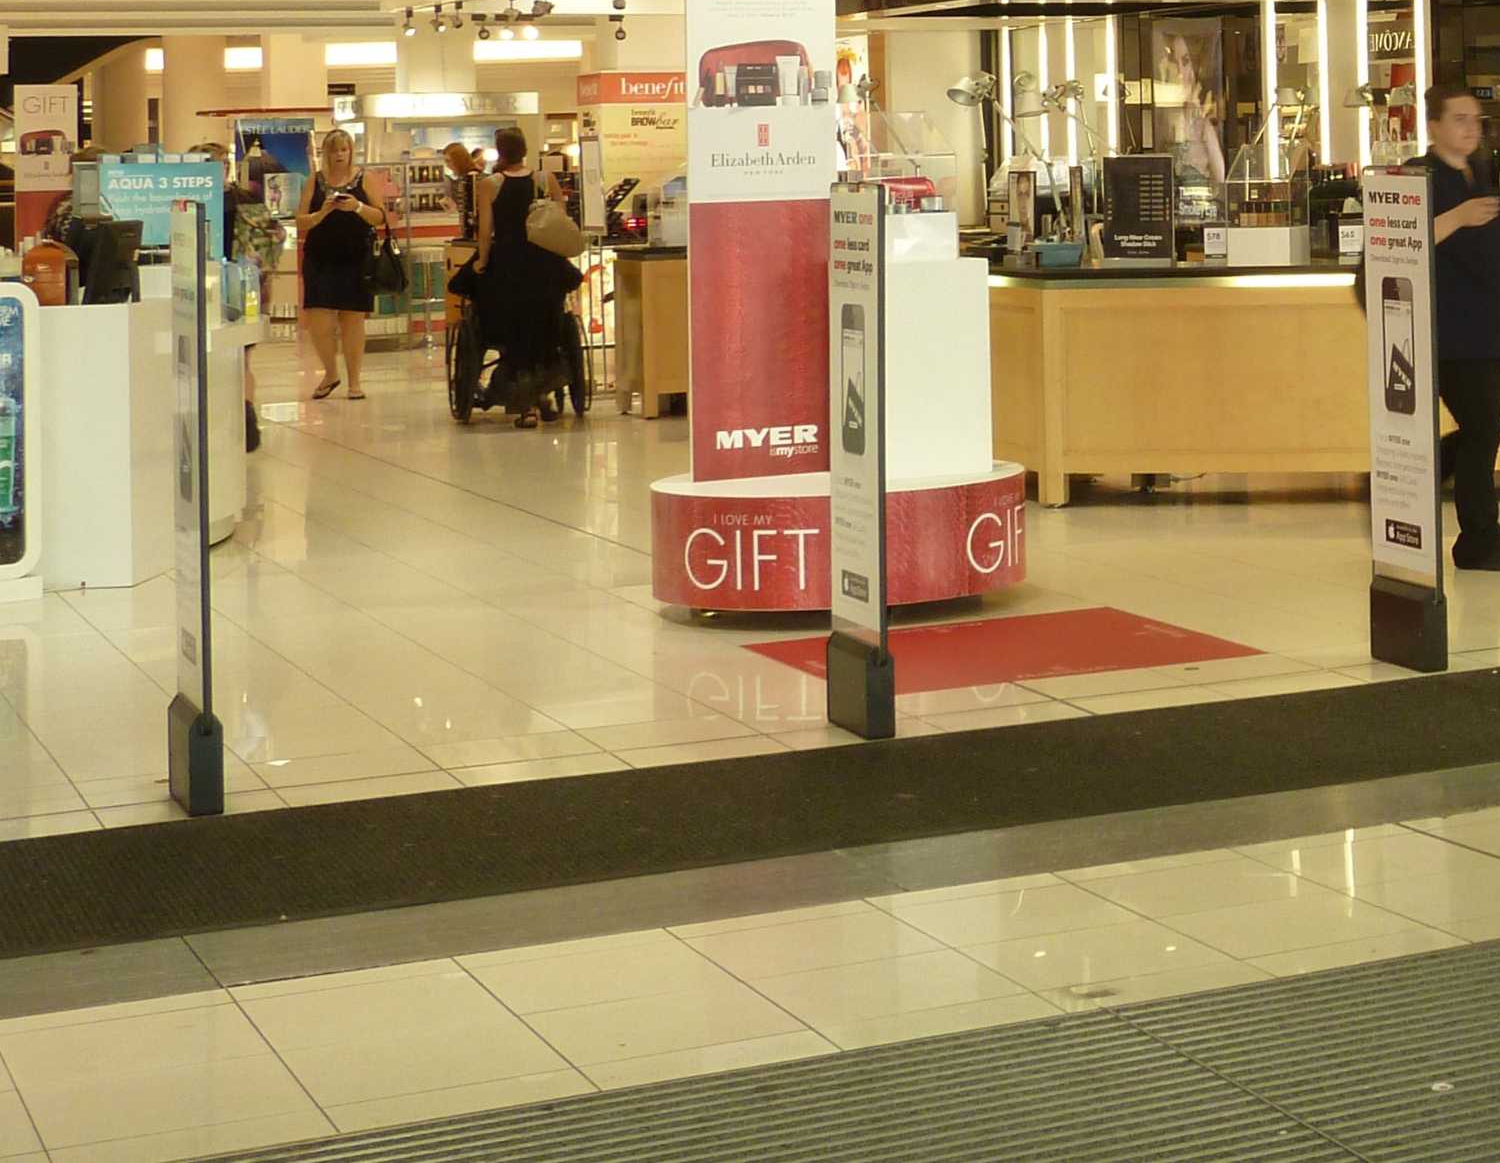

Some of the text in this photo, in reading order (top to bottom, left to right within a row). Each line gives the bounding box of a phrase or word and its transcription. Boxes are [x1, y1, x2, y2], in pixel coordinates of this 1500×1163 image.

[621, 76, 685, 100] benefit
[22, 95, 69, 114] GIFT
[711, 151, 816, 168] Elizabeth Arden
[108, 176, 214, 190] AQUA 3 STEPS
[1368, 191, 1421, 206] MYER one
[834, 210, 873, 225] MYER one
[1369, 216, 1417, 230] one less card
[1370, 235, 1422, 252] one great App
[716, 423, 818, 450] MYER
[720, 513, 750, 526] LOVE
[753, 514, 772, 526] MY
[966, 501, 1025, 574] GIF
[684, 527, 820, 591] GIFT
